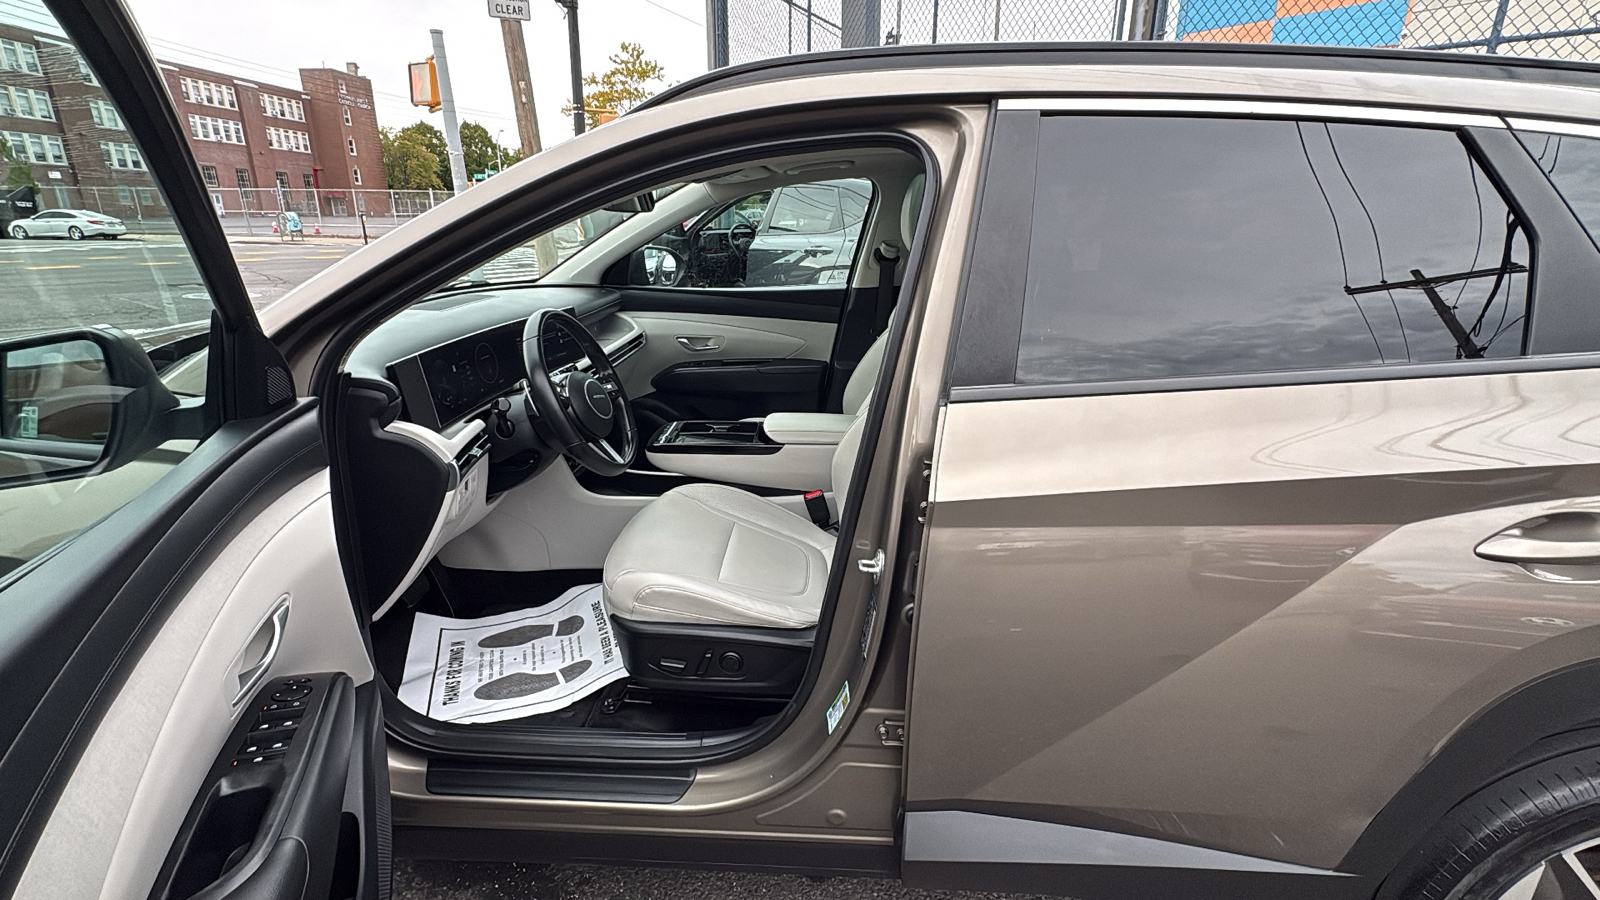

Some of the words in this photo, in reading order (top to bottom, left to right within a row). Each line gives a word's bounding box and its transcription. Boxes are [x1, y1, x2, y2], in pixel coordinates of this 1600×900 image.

[495, 3, 524, 16] CLEAR
[591, 600, 608, 632] PLEASURE
[450, 640, 465, 648] IN
[600, 635, 612, 650] BEEN
[447, 647, 465, 668] COMING
[602, 648, 613, 659] HAS
[446, 668, 463, 680] FOR
[442, 680, 461, 706] THANKS
